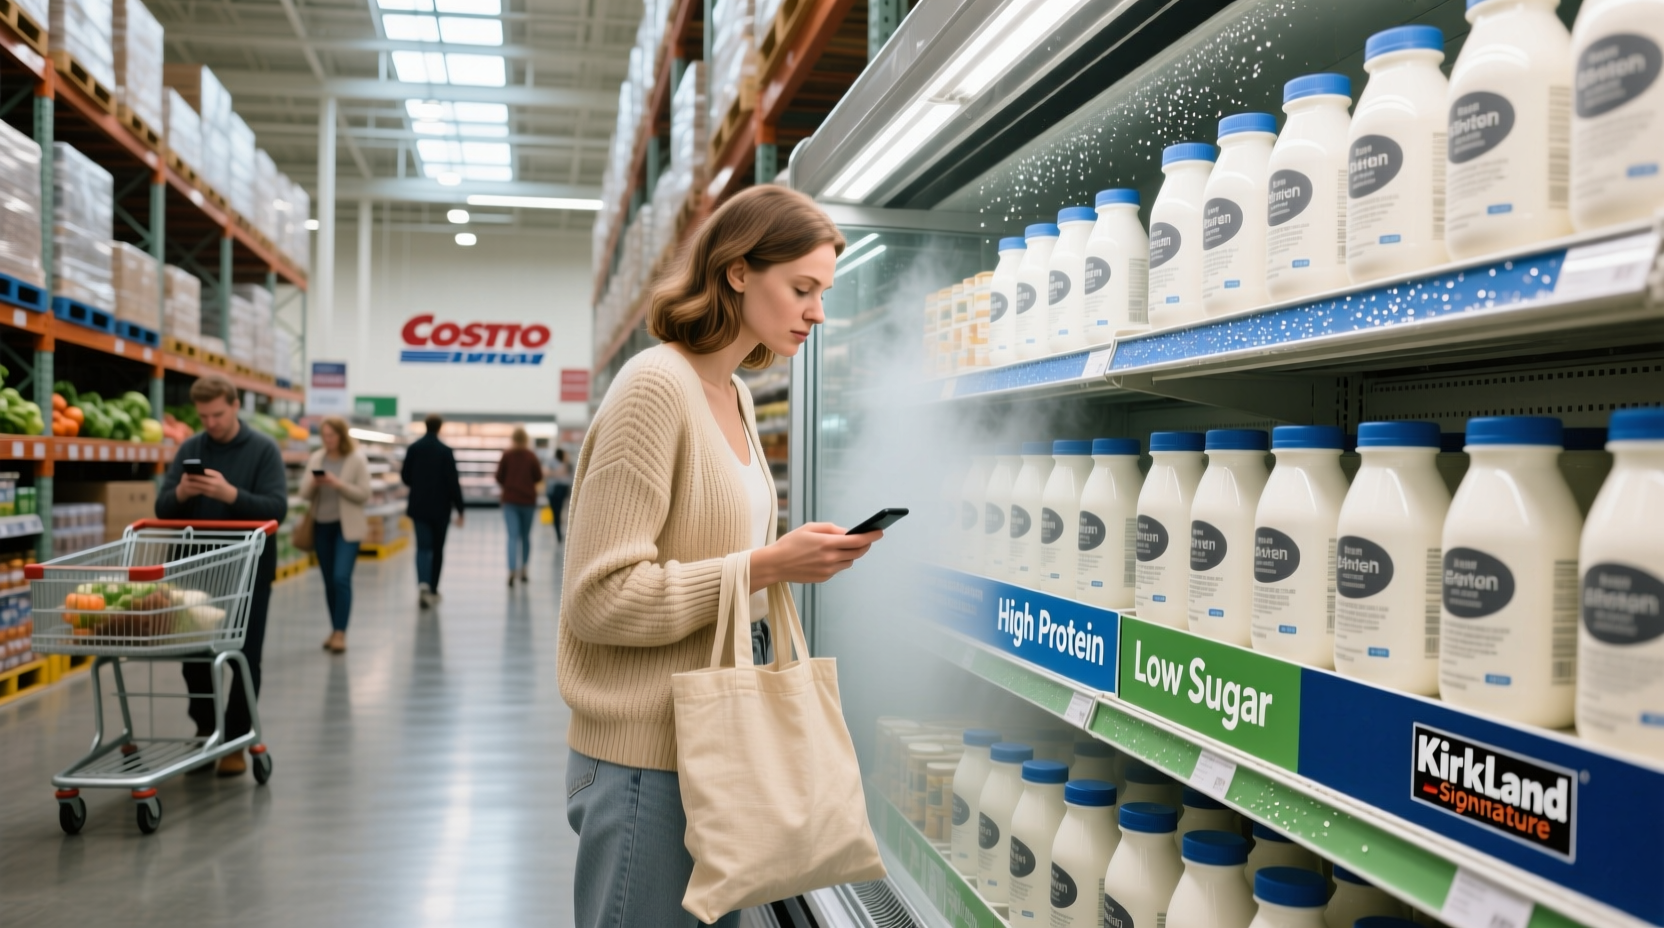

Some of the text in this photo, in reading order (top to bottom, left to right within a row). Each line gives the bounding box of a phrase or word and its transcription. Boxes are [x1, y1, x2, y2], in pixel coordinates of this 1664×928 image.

[997, 597, 1034, 647] High
[1038, 609, 1104, 666] Protein
[1134, 639, 1273, 731] Low Sugar
[1417, 734, 1569, 823] KirkLand
